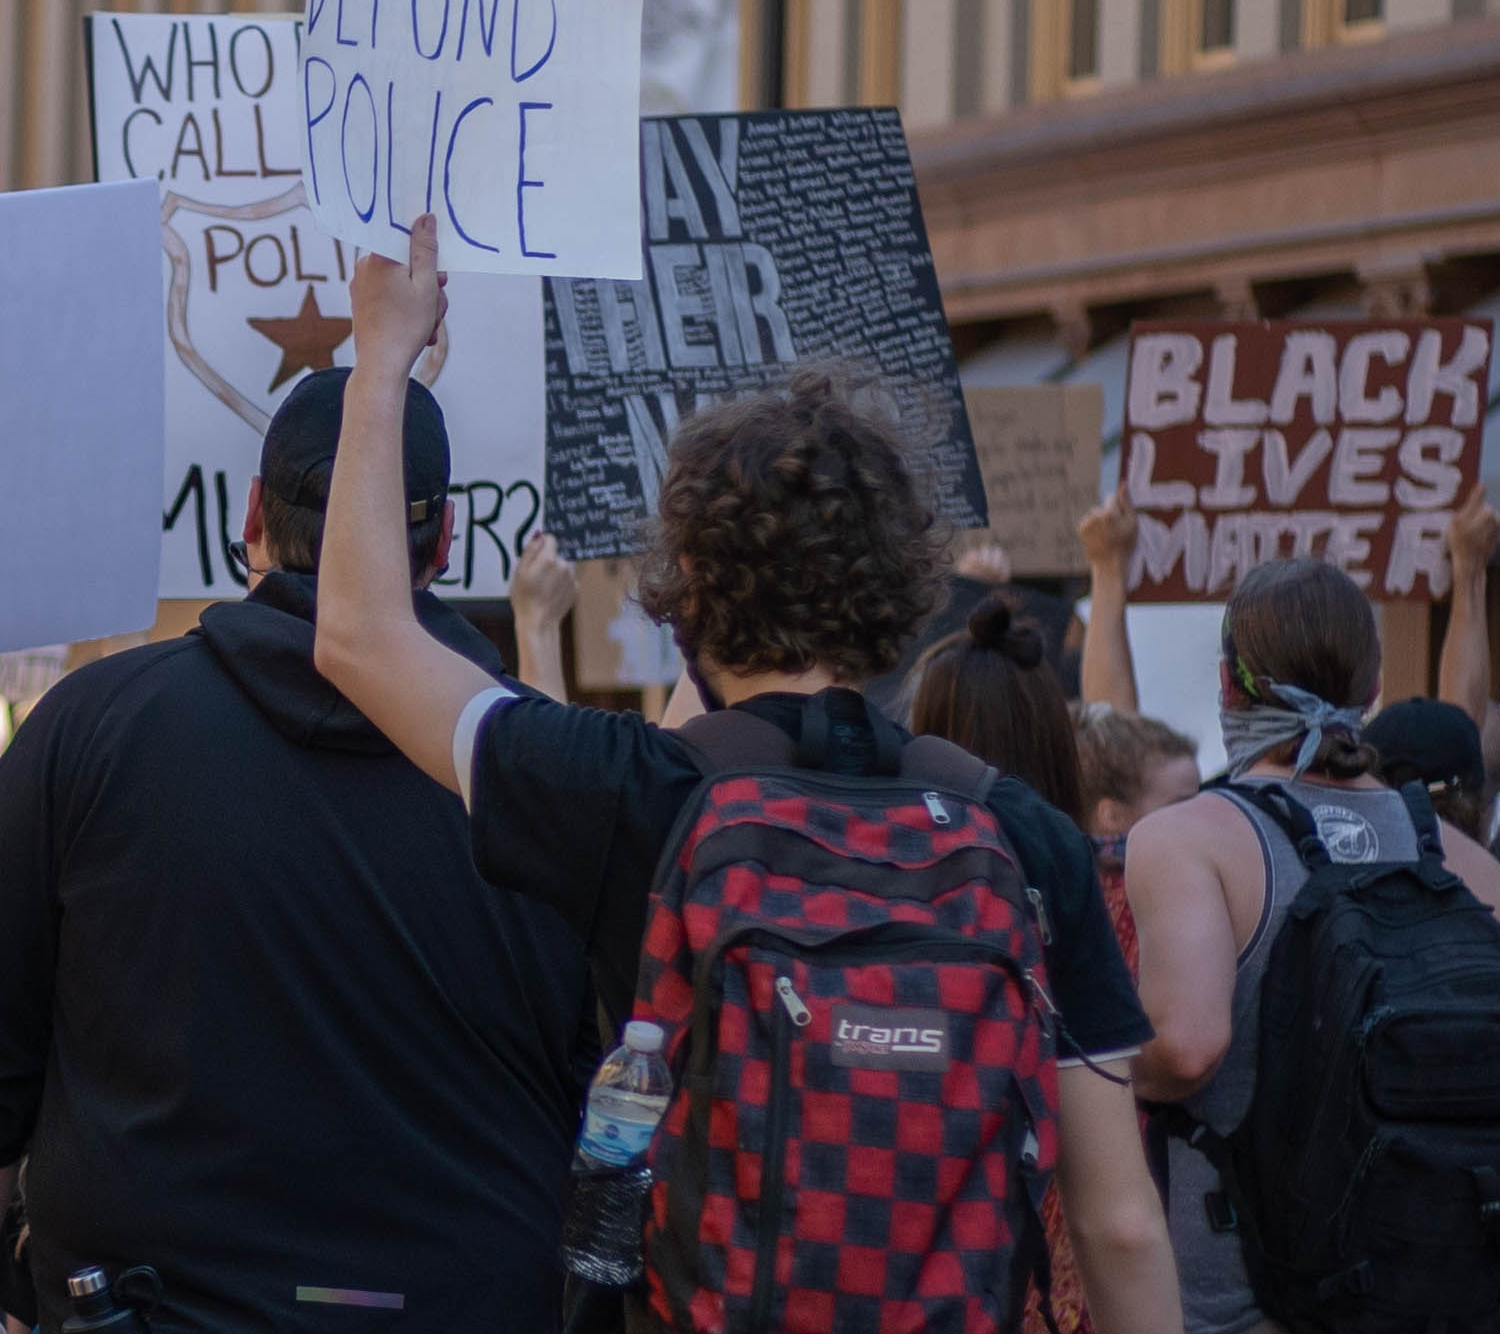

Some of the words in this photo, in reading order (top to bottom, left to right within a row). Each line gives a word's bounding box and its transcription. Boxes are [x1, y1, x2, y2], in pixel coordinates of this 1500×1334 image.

[112, 17, 274, 103] WHO
[122, 103, 303, 181] CALL
[305, 57, 557, 259] POLICE
[204, 225, 358, 292] POLI
[1129, 325, 1489, 431] BLACK
[1128, 426, 1464, 509] LIVES
[838, 1019, 944, 1053] trans
